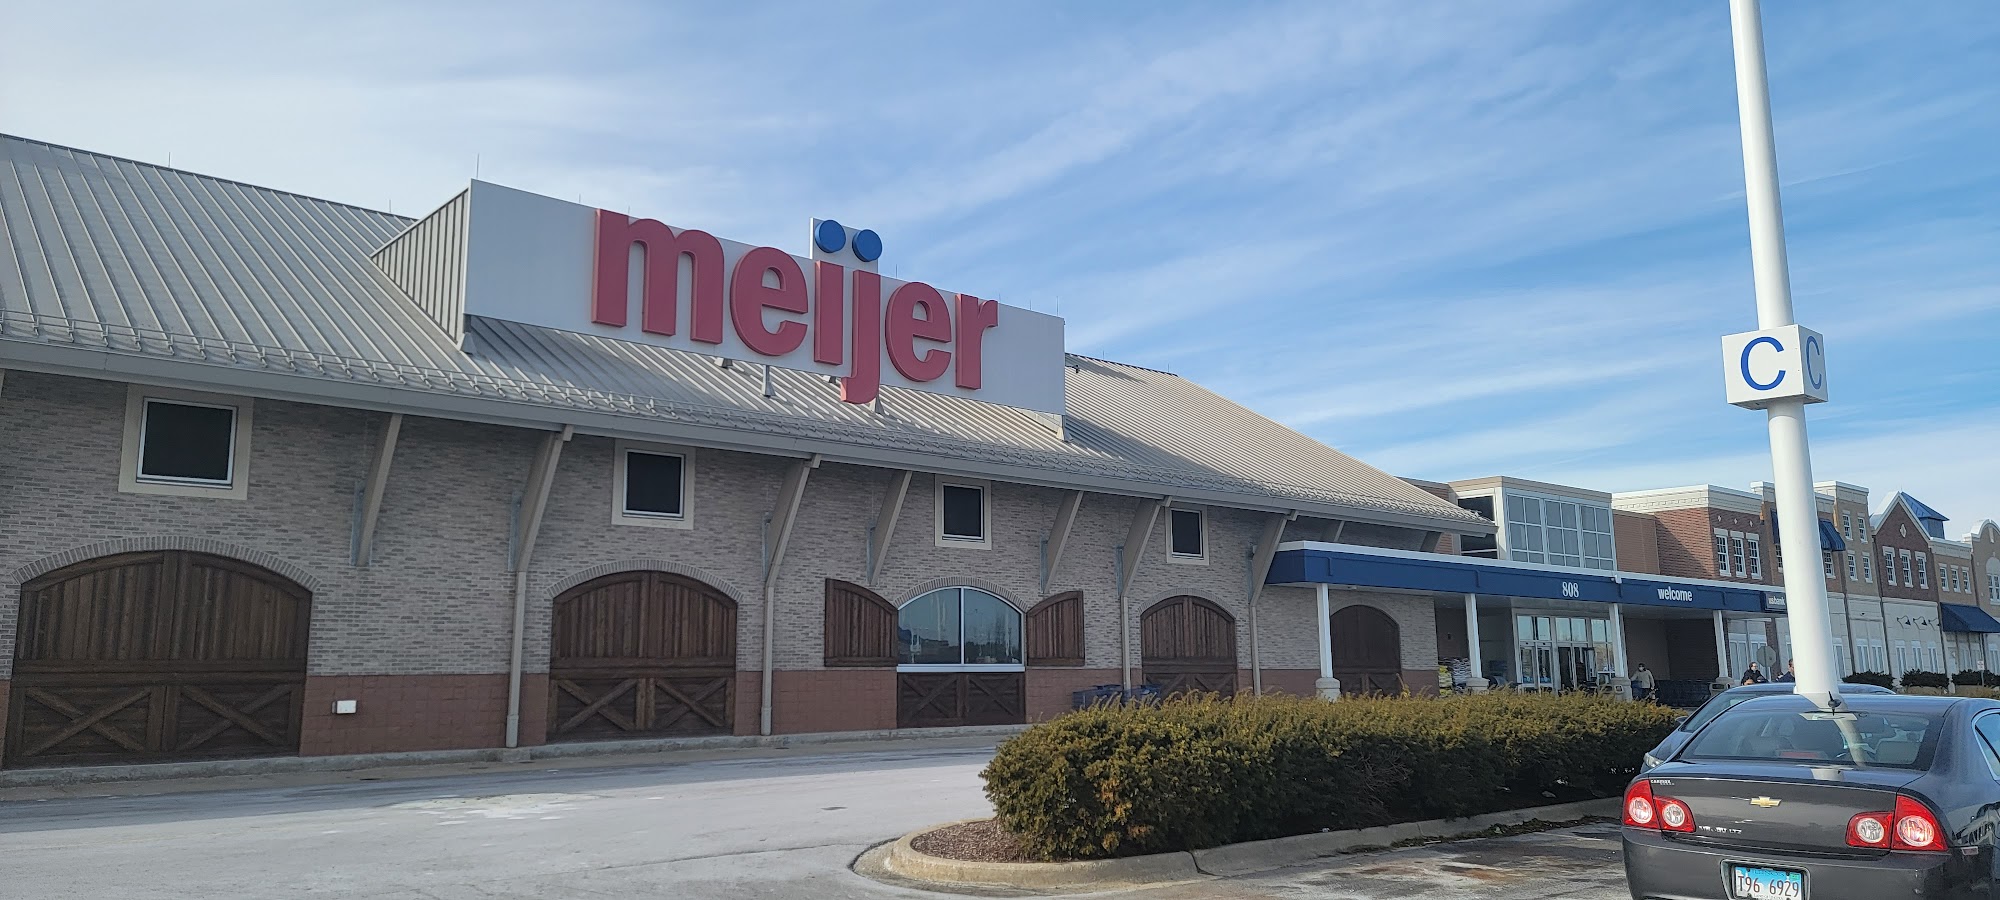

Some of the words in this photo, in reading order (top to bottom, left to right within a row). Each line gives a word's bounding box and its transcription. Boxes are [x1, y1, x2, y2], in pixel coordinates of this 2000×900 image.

[591, 208, 998, 404] meijer
[1740, 336, 1786, 391] C
[1806, 335, 1822, 390] C
[1562, 581, 1580, 598] 808
[1657, 586, 1693, 601] welcome
[1738, 875, 1760, 893] T96
[1769, 879, 1799, 898] 6929
